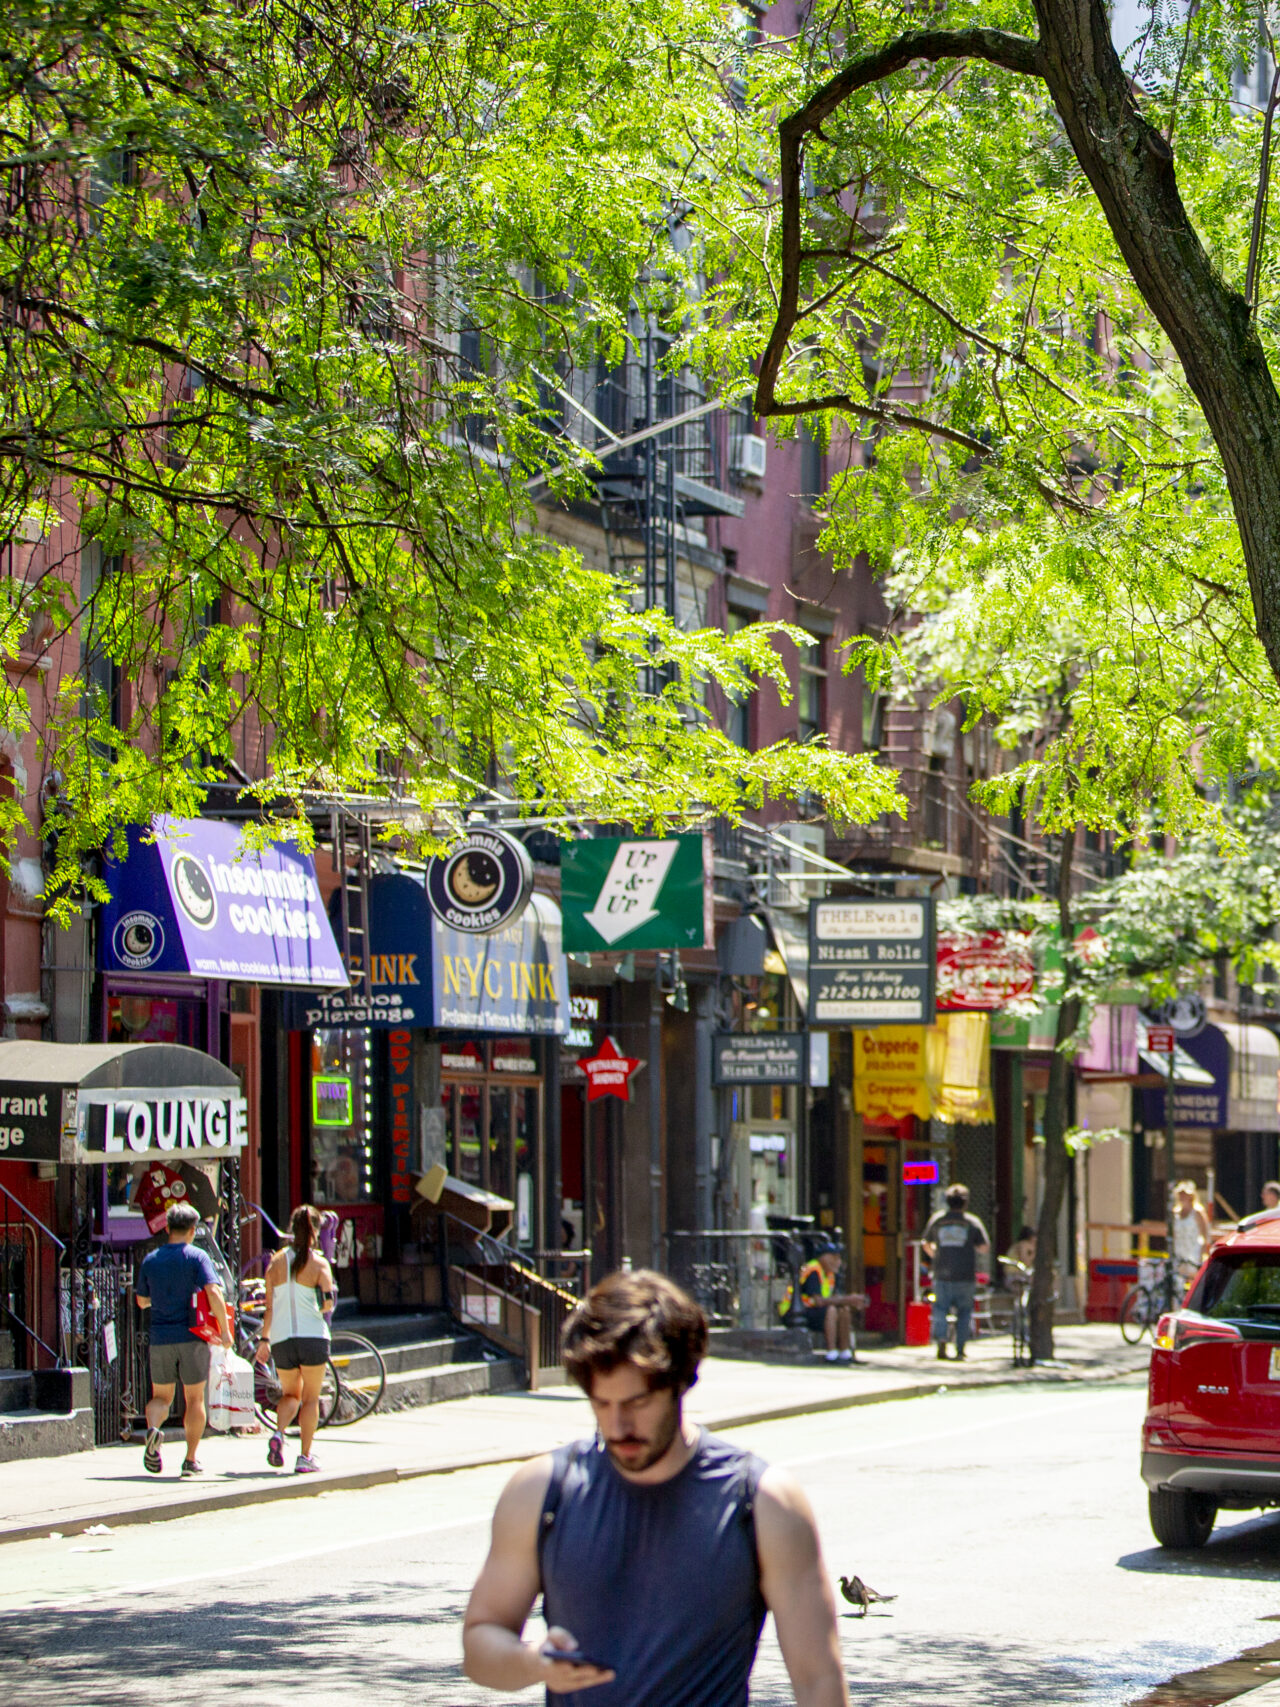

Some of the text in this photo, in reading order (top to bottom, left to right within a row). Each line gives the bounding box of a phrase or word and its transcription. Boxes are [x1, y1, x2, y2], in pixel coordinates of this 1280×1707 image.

[444, 834, 505, 859] nsomnia
[207, 853, 316, 902] insomnia
[229, 898, 321, 940] cookies
[446, 907, 501, 928] cookies
[370, 953, 421, 986] INK
[818, 944, 921, 960] Nizami Rolls
[442, 952, 558, 1001] NYC INK
[317, 993, 402, 1010] Tatoos
[388, 1030, 411, 1074] ODY
[105, 1097, 249, 1154] LOUNGE
[391, 1083, 411, 1202] PIERCING
